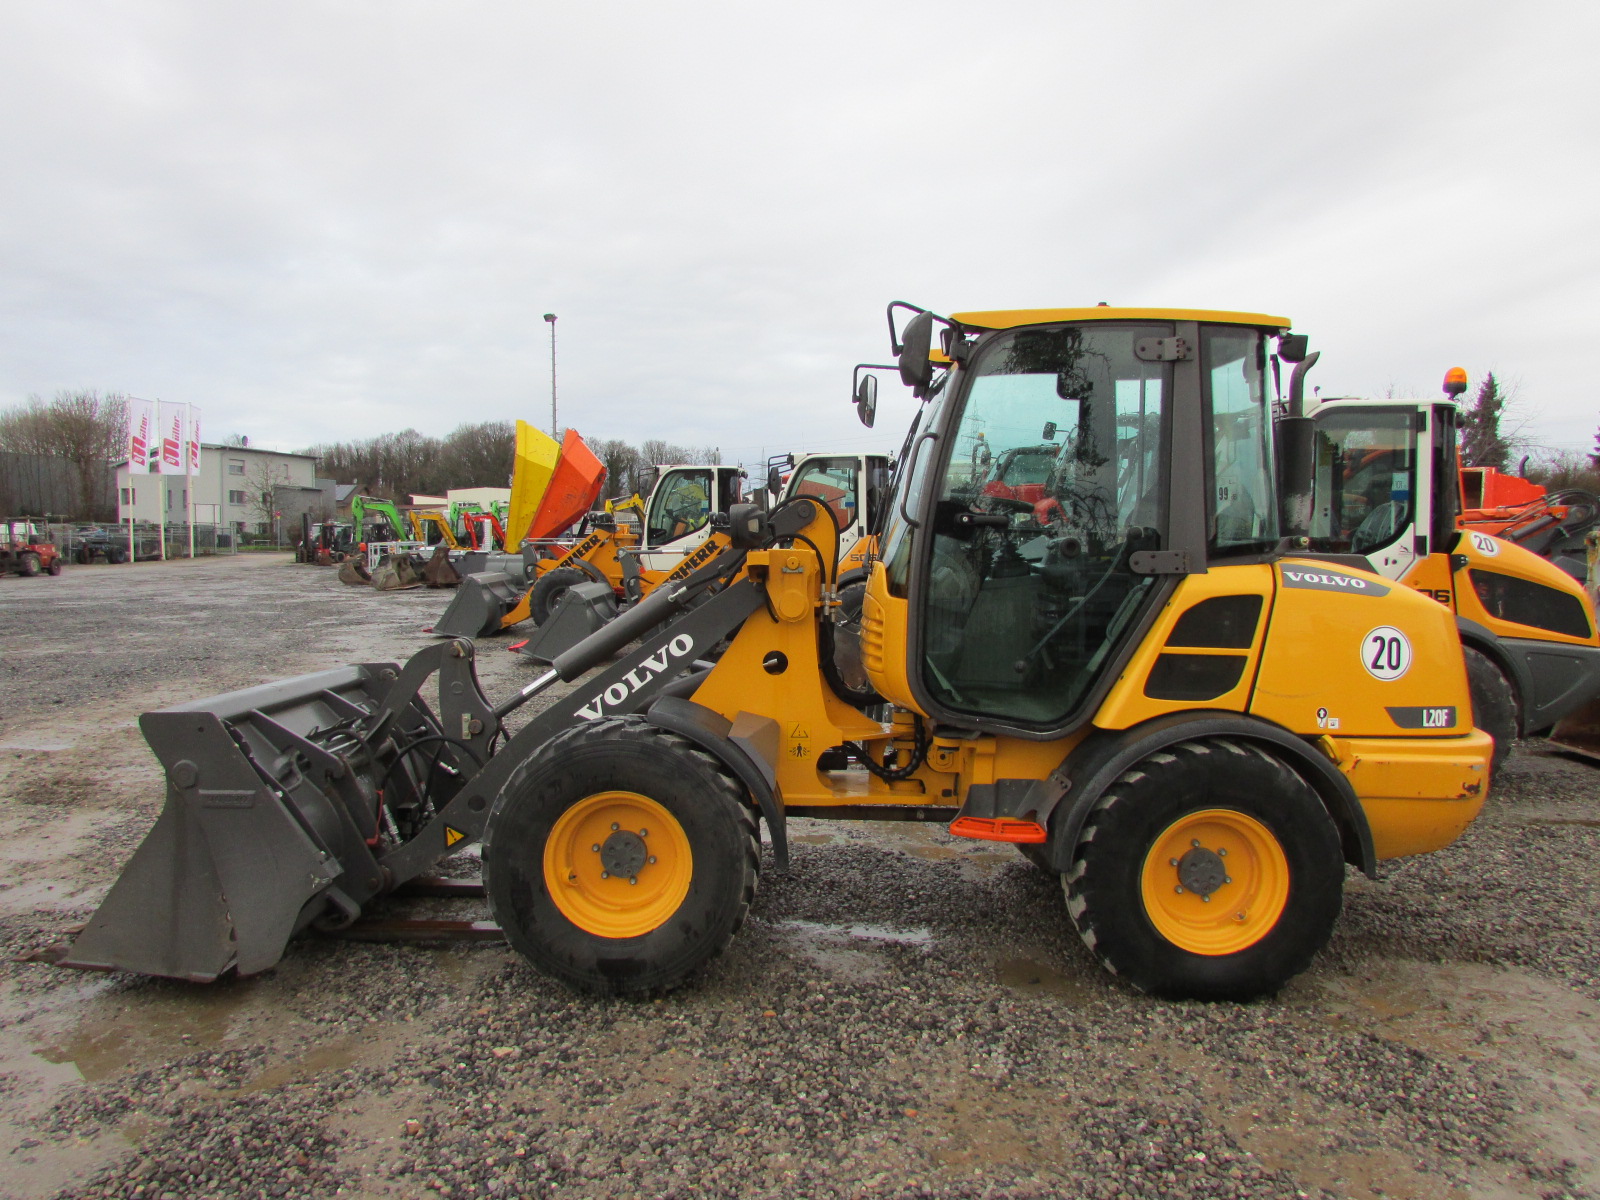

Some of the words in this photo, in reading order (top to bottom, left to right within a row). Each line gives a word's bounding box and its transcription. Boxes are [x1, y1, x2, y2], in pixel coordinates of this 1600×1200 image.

[1218, 487, 1229, 501] 99
[557, 534, 602, 569] BHERR
[1473, 534, 1494, 553] 20
[663, 539, 720, 583] BHERR
[1283, 571, 1367, 589] VOLVO
[1371, 635, 1401, 671] 20
[573, 633, 694, 721] VOLVO
[1422, 708, 1449, 727] L20F
